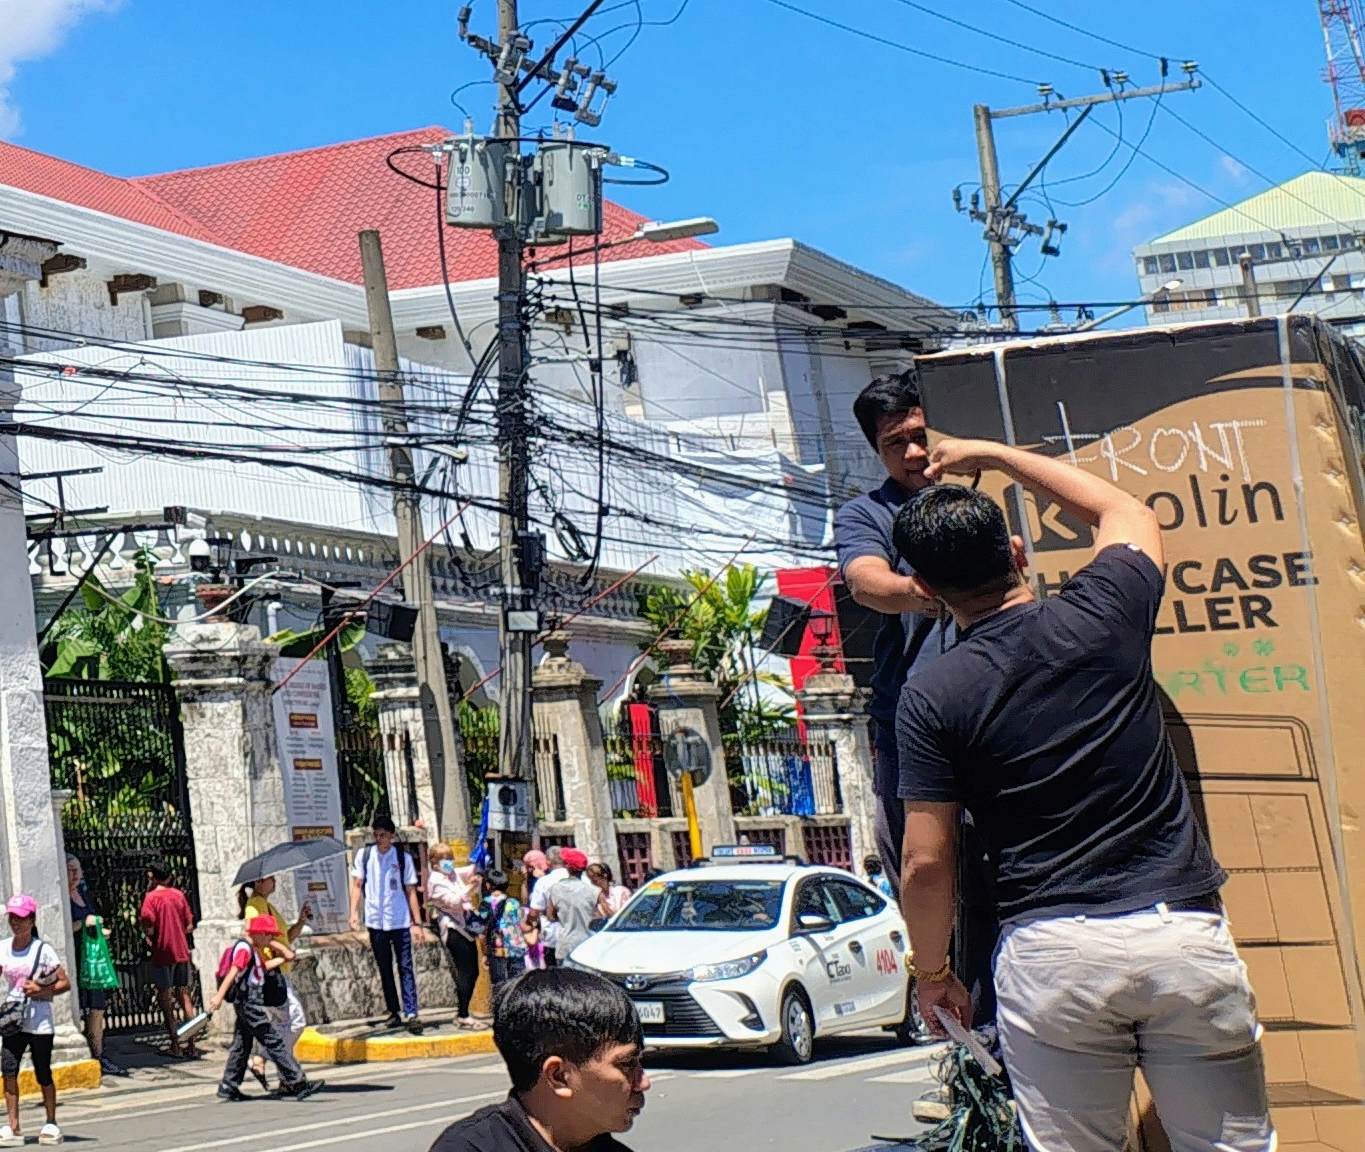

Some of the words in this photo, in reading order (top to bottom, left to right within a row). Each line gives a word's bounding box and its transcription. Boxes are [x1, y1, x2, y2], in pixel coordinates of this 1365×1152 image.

[1042, 401, 1268, 482] FRONT
[1143, 473, 1285, 532] olin
[876, 949, 898, 976] 4104
